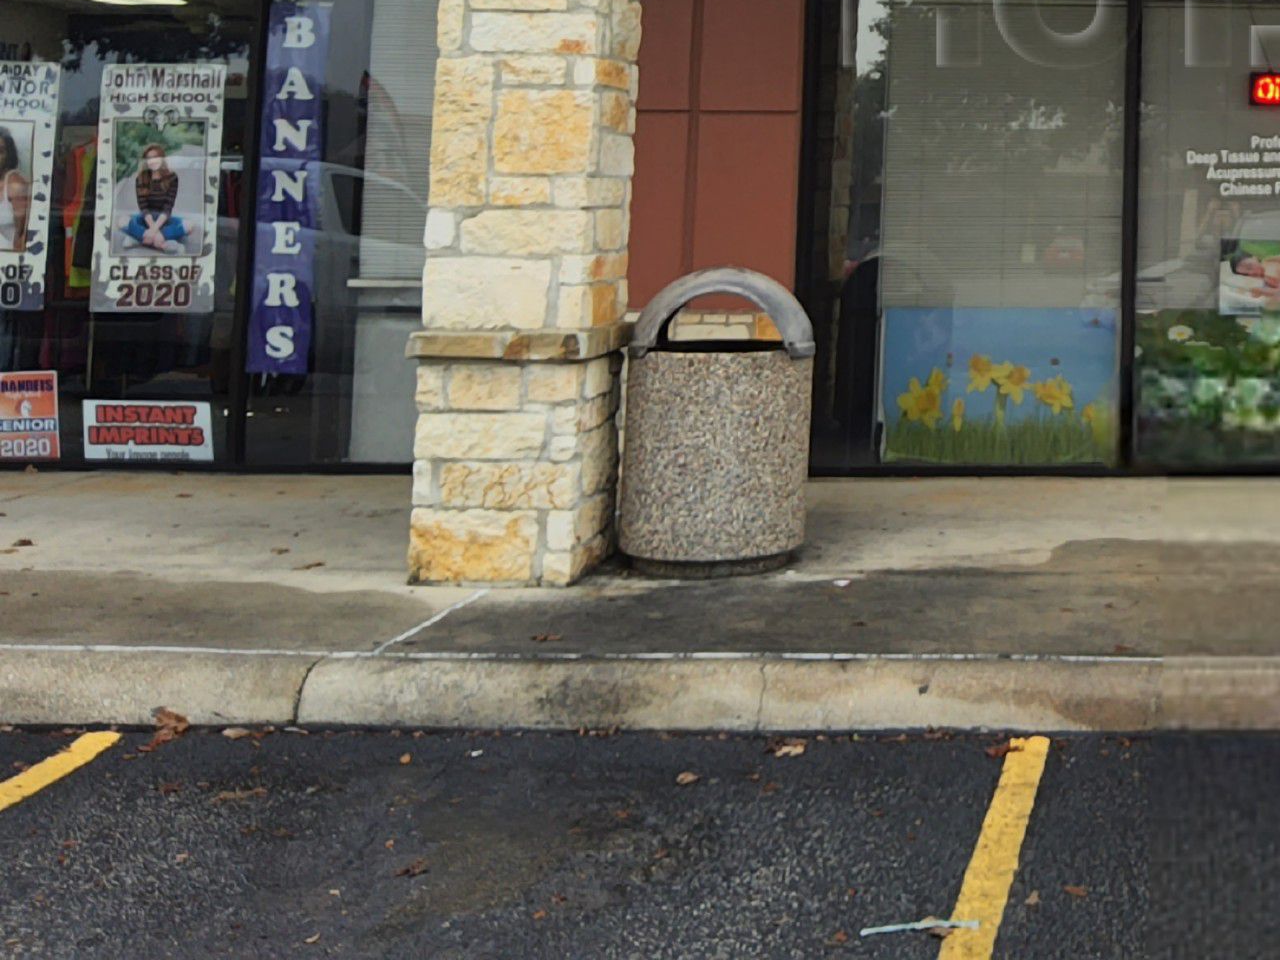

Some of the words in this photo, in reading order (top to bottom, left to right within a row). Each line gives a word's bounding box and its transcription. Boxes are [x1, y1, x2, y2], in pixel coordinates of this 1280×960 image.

[105, 68, 146, 88] John
[152, 67, 221, 88] Marshall
[110, 92, 149, 103] HIGH
[152, 92, 214, 103] SCHOOL
[1186, 150, 1218, 165] Deep
[1220, 149, 1260, 163] Tissue
[264, 16, 315, 359] BANNERS
[1220, 182, 1272, 196] Chinese
[110, 266, 173, 280] CLASS
[179, 266, 202, 280] OF
[116, 283, 191, 307] 2020
[96, 405, 197, 425] INSTANT
[0, 419, 55, 431] ENIOR
[88, 426, 205, 445] IMPRINTS
[1, 438, 51, 457] 2020
